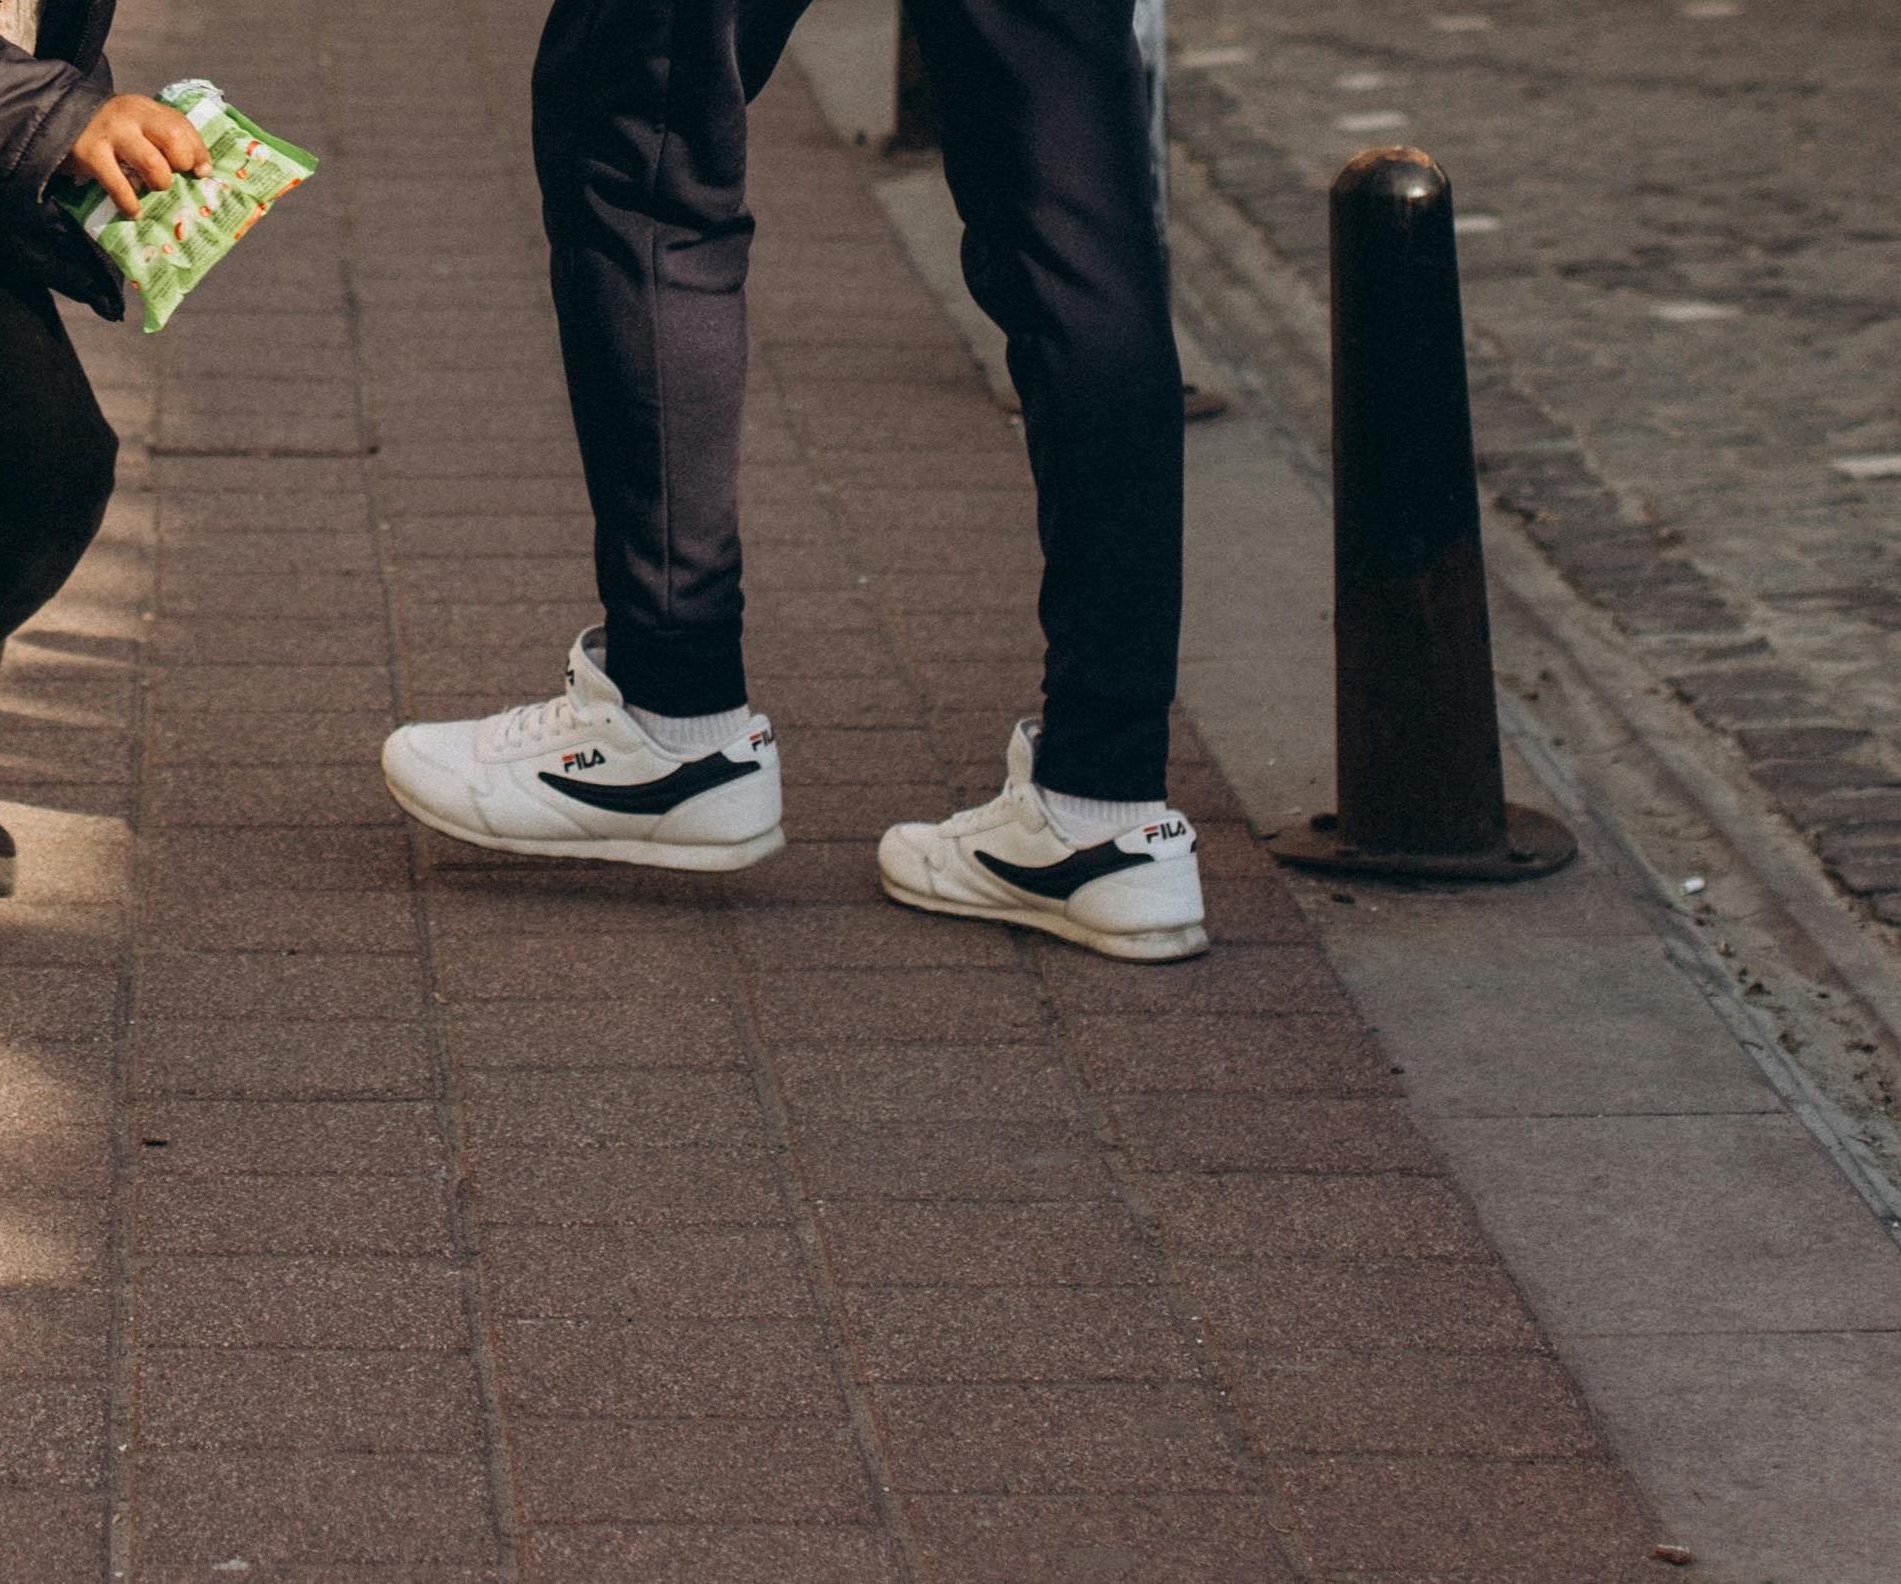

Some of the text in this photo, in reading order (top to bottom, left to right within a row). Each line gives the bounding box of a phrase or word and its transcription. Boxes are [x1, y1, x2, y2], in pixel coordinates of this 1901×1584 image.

[749, 729, 775, 752] FIL
[562, 748, 607, 773] FILA
[1143, 820, 1187, 844] FILA
